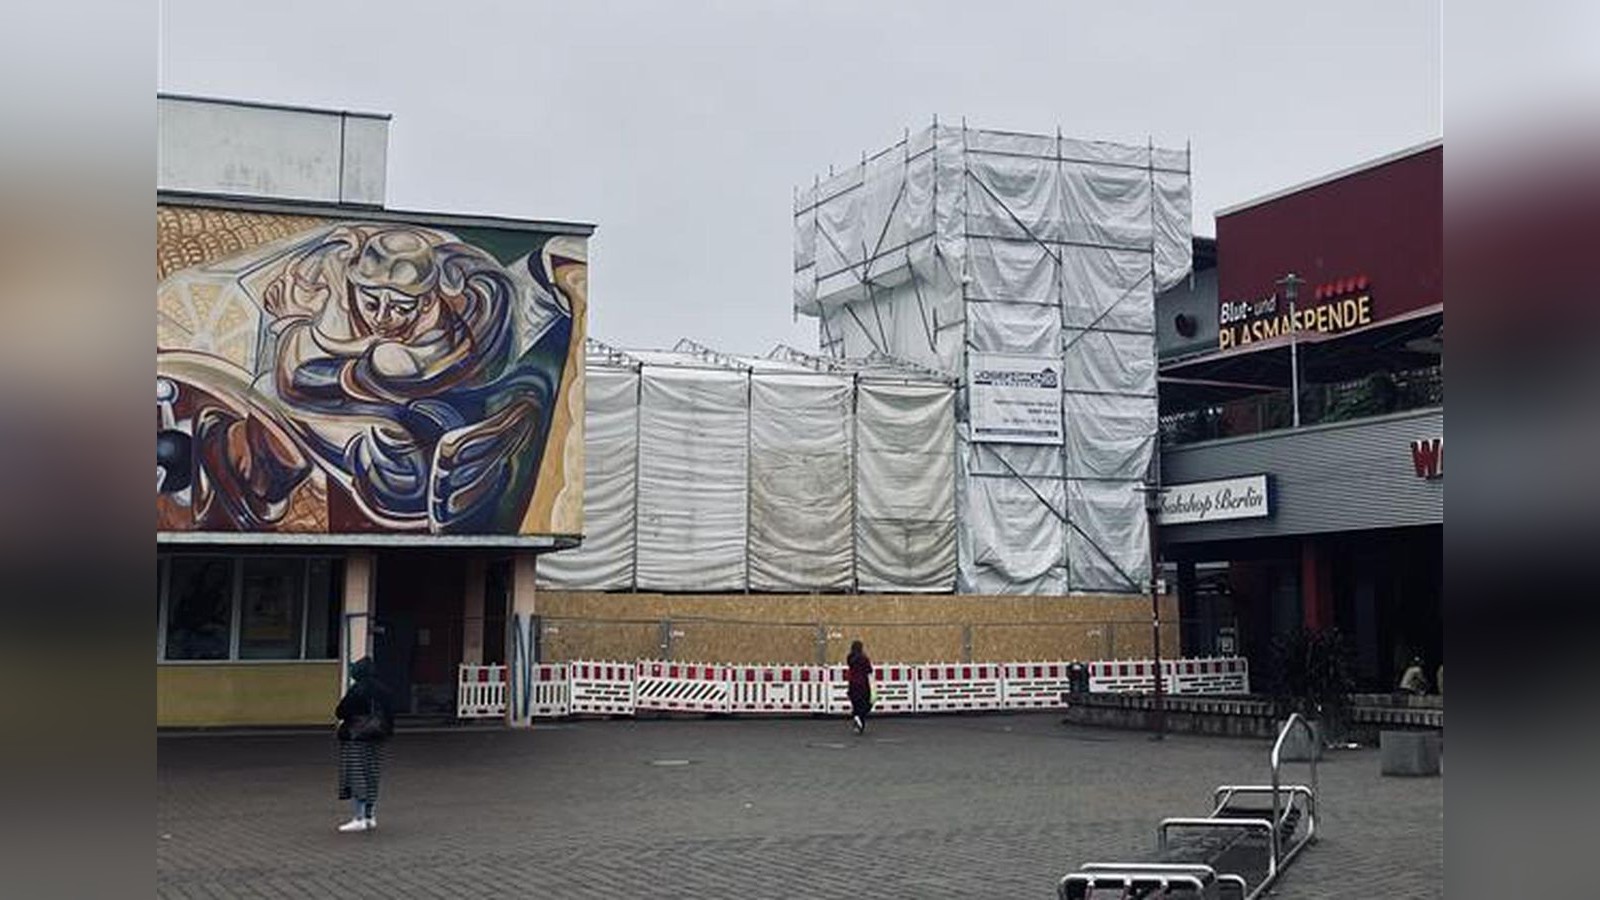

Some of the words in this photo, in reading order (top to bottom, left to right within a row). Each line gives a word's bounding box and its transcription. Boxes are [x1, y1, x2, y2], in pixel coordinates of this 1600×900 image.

[1219, 296, 1371, 350] PLASMASPENDE
[1220, 301, 1252, 324] Blut-
[1410, 439, 1443, 479] W
[1215, 485, 1263, 510] Berlin
